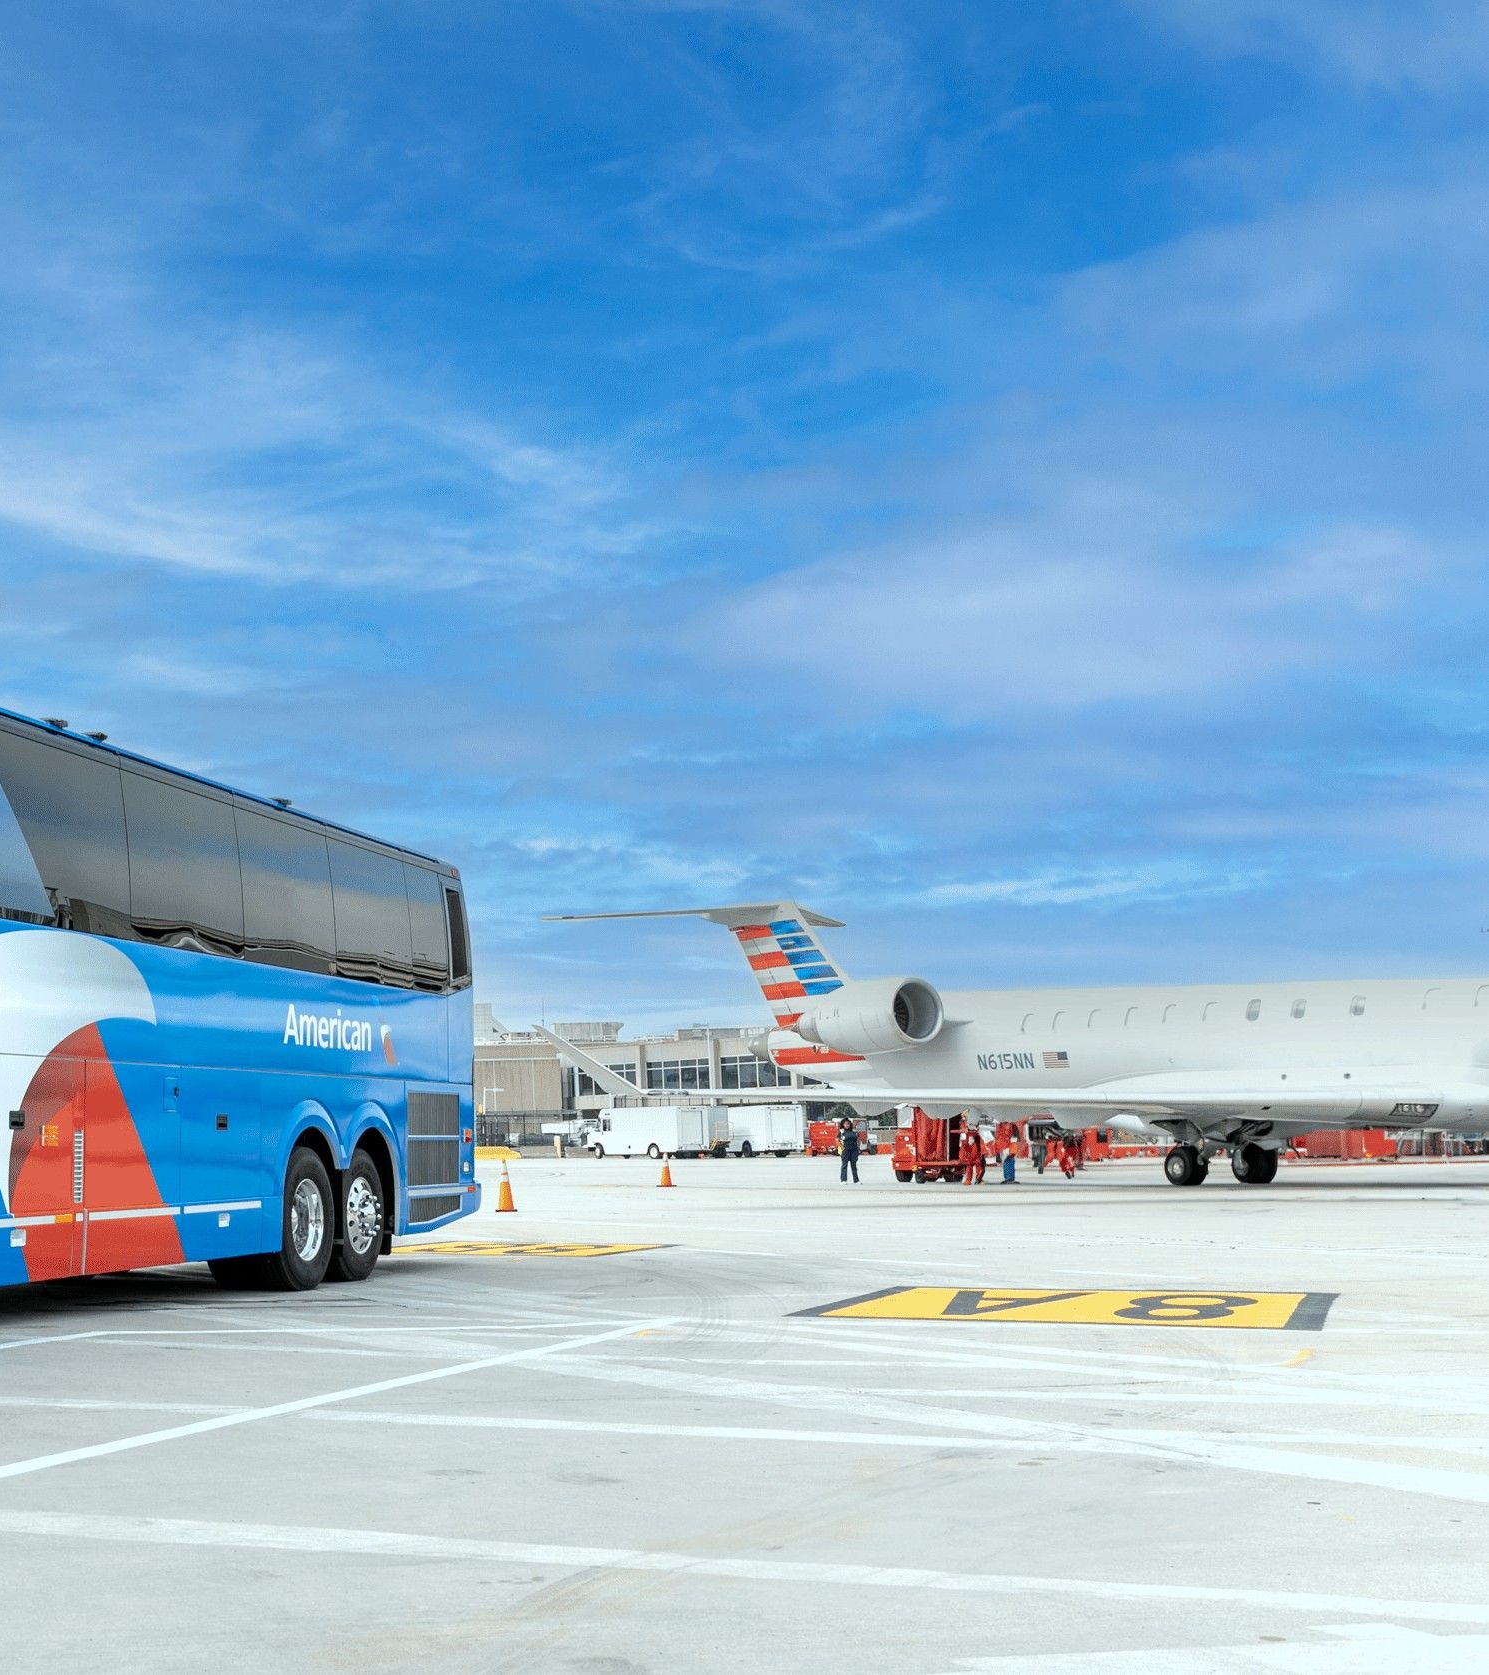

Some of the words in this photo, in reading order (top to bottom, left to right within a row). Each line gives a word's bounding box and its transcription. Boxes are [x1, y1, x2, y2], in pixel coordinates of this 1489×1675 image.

[283, 1003, 372, 1052] American
[977, 1052, 1035, 1071] N615NN
[941, 1291, 1259, 1321] 8A
